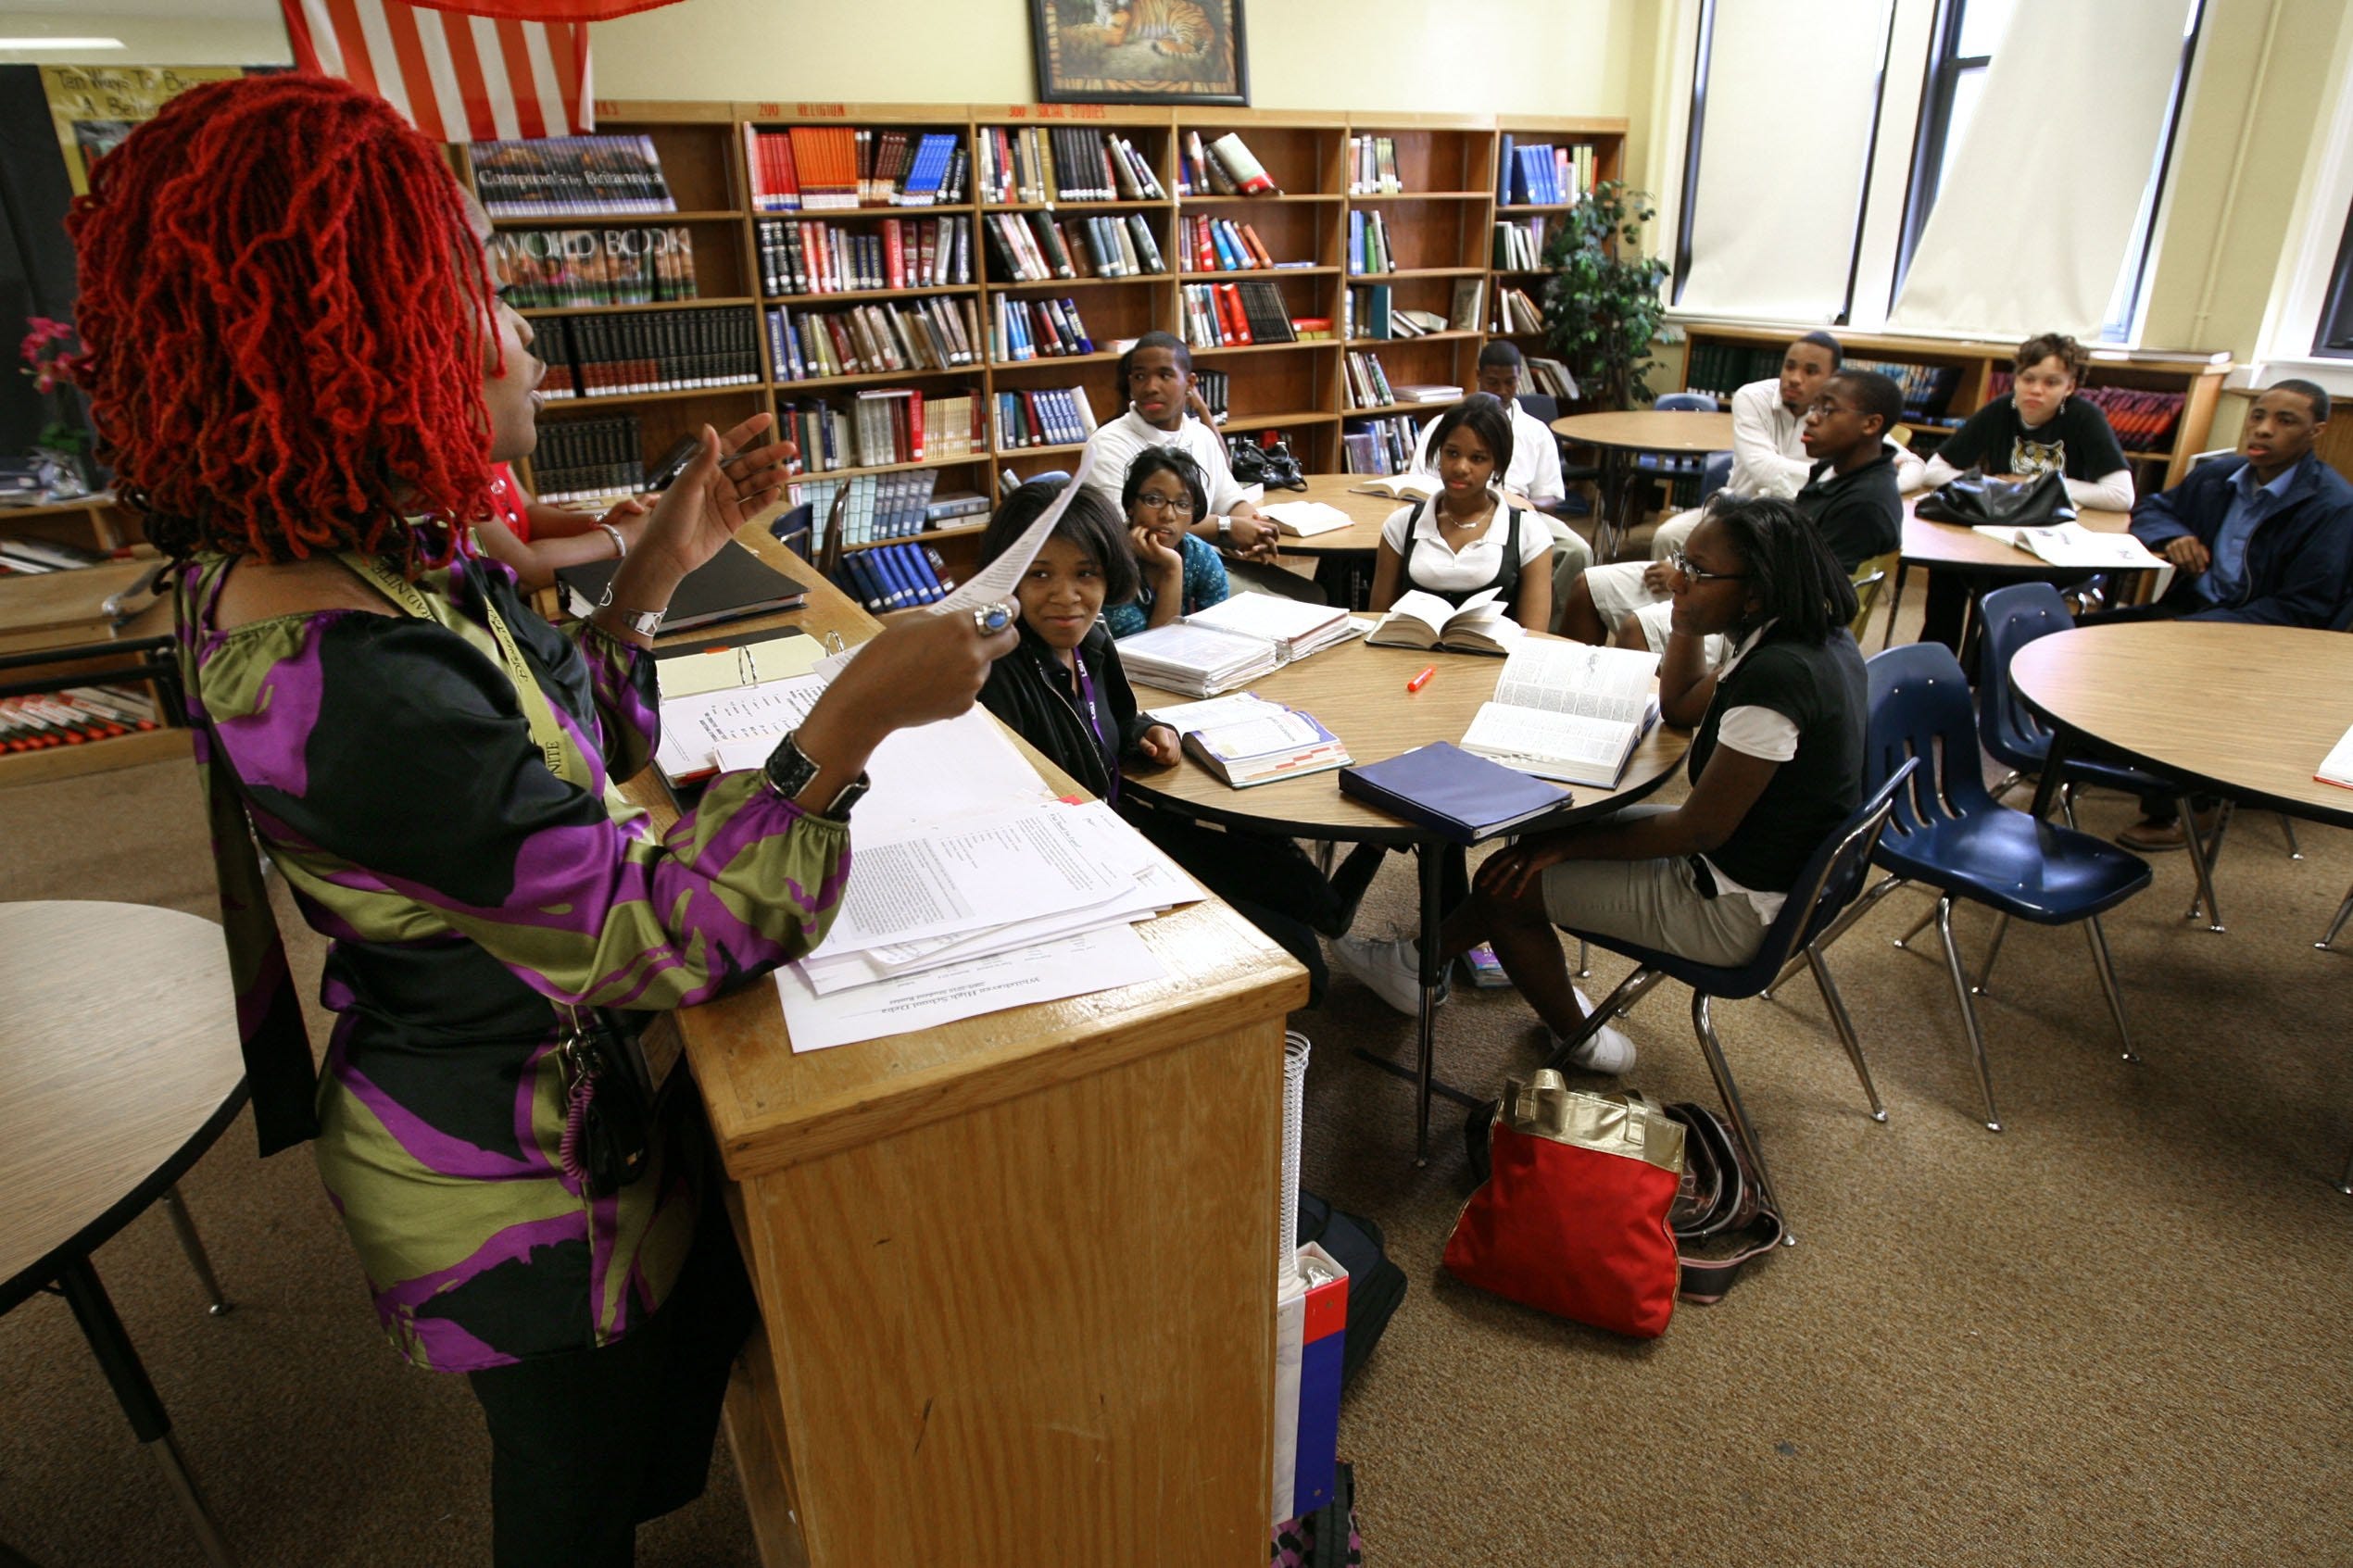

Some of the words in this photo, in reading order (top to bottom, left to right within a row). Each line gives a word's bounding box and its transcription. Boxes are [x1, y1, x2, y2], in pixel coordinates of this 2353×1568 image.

[51, 69, 90, 91] Ten
[91, 68, 132, 92] Ways
[132, 69, 156, 90] To
[81, 95, 98, 118] A
[759, 102, 780, 117] 200
[797, 102, 847, 118] RELIGION
[1038, 103, 1065, 119] SOCIAL
[1069, 104, 1106, 119] STUDIES
[478, 169, 566, 189] Compton's
[568, 175, 583, 186] by
[584, 169, 664, 186] Britannica
[496, 230, 598, 261] WORLD
[603, 227, 692, 257] BOOK
[371, 562, 410, 596] NITE
[545, 741, 563, 774] NITE
[978, 975, 1041, 994] Whitehaven
[912, 997, 949, 1010] School
[950, 990, 977, 1004] High
